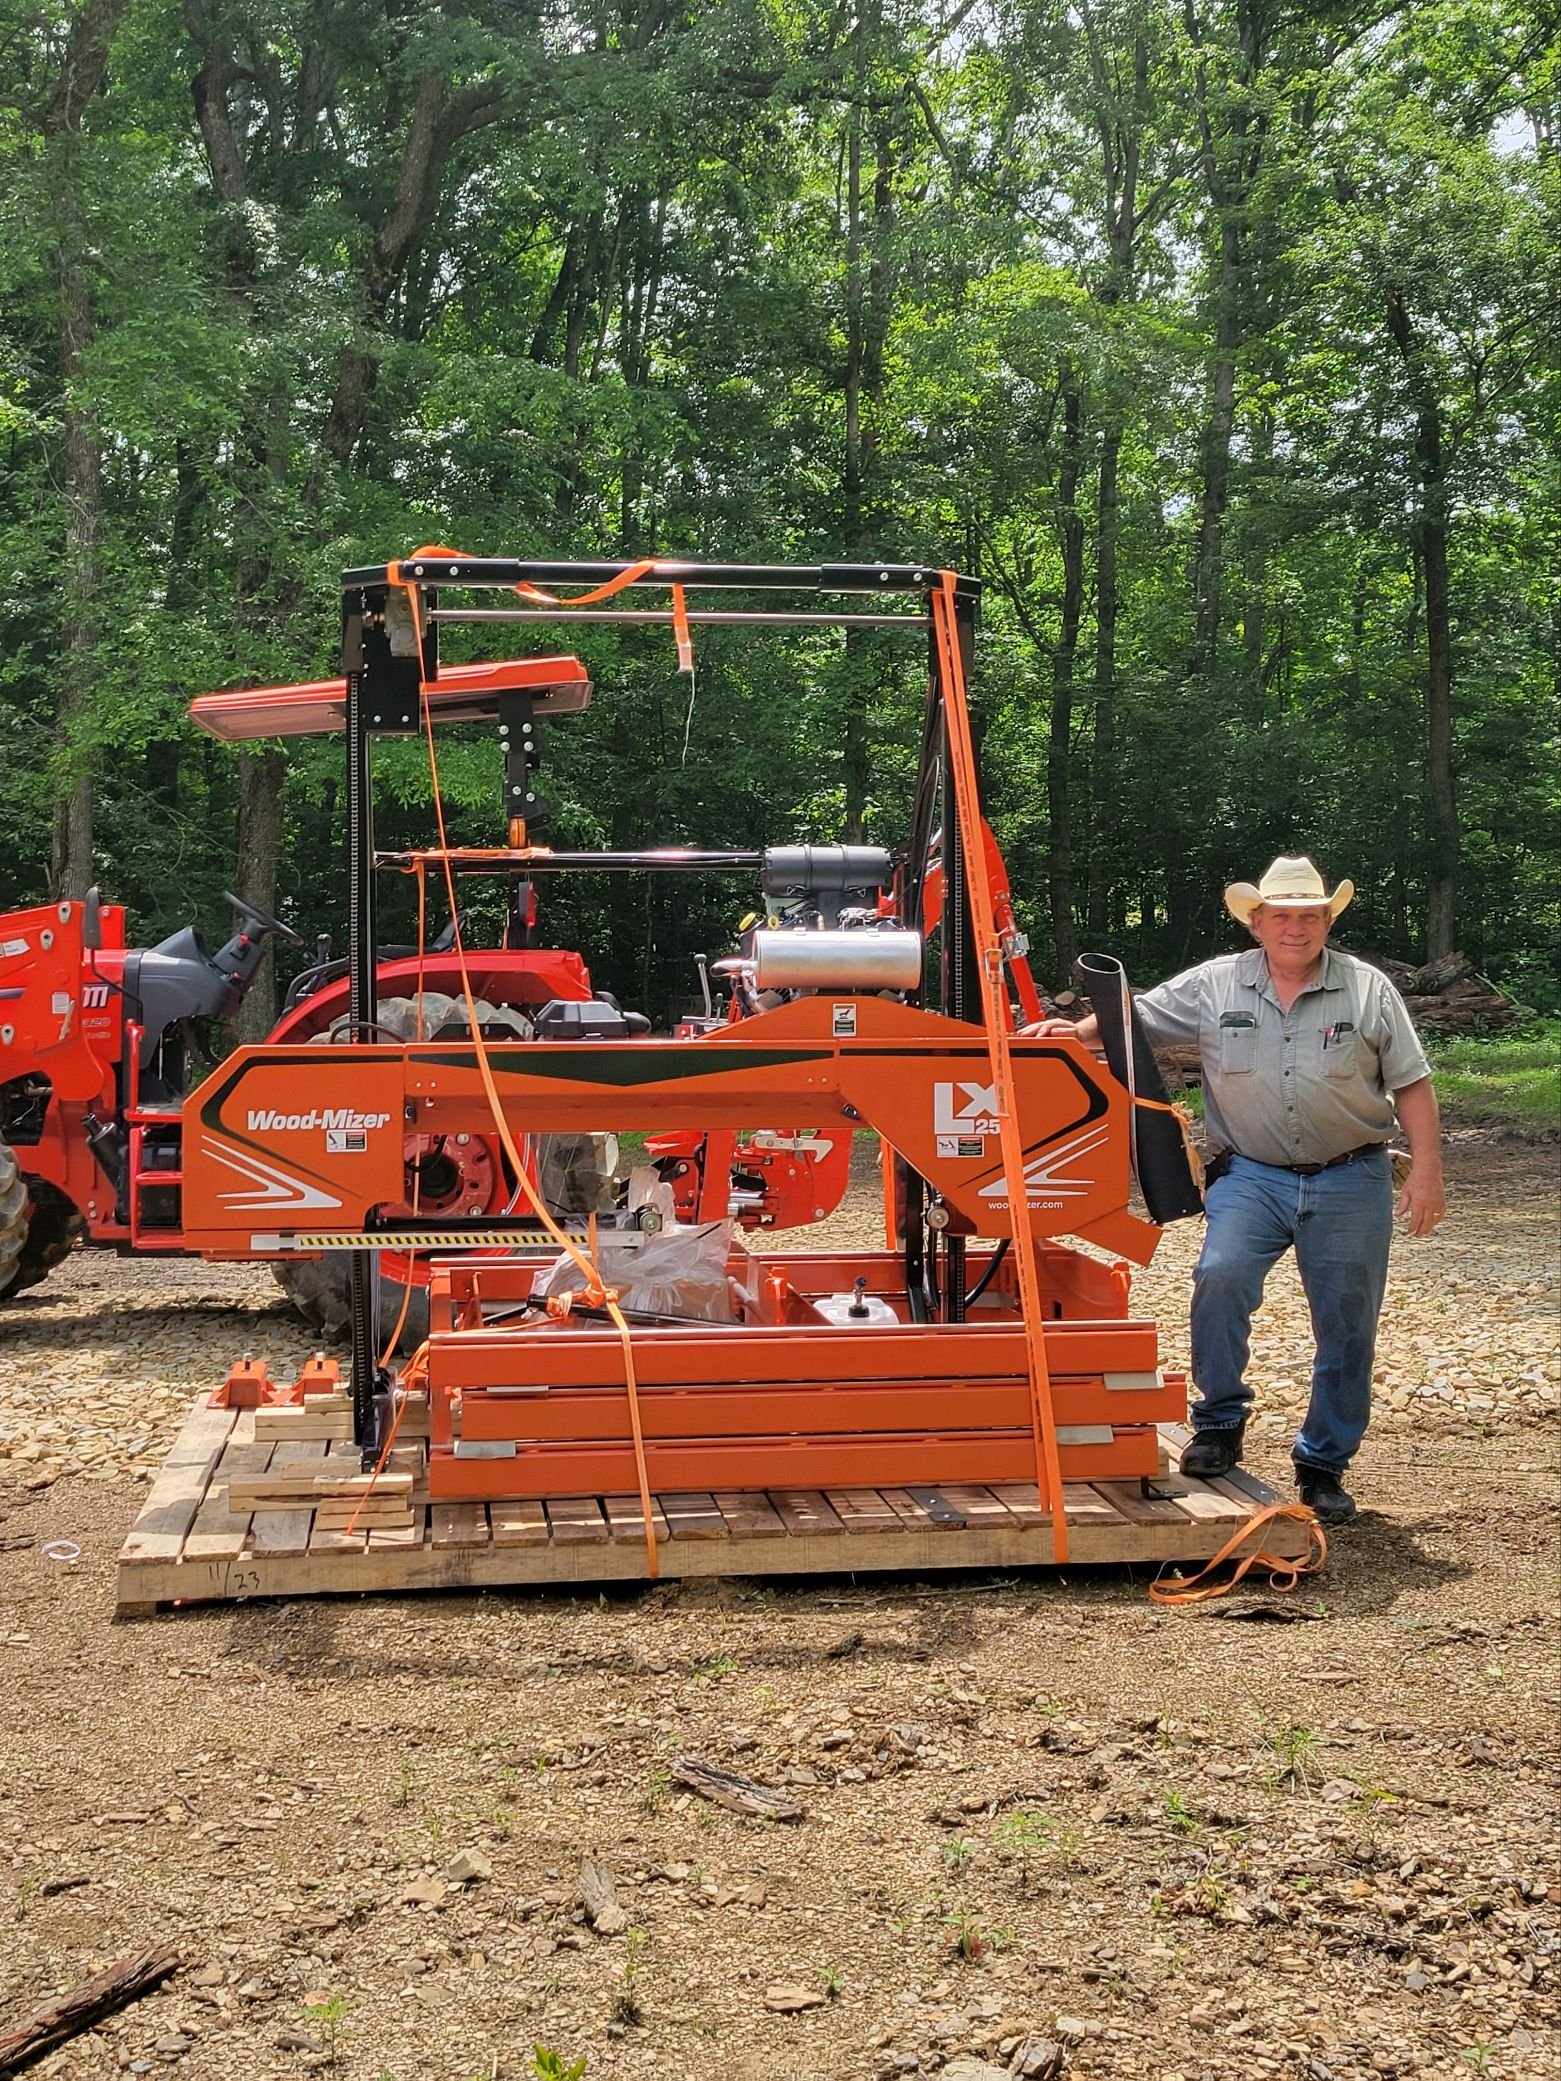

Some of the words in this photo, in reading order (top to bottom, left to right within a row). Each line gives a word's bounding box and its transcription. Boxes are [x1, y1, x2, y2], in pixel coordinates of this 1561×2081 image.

[248, 1109, 390, 1131] Wood-Mizer
[934, 1082, 1001, 1135] LX
[975, 1119, 1001, 1135] 25
[988, 1201, 1063, 1209] woozer.com
[209, 1561, 260, 1597] 11/23
